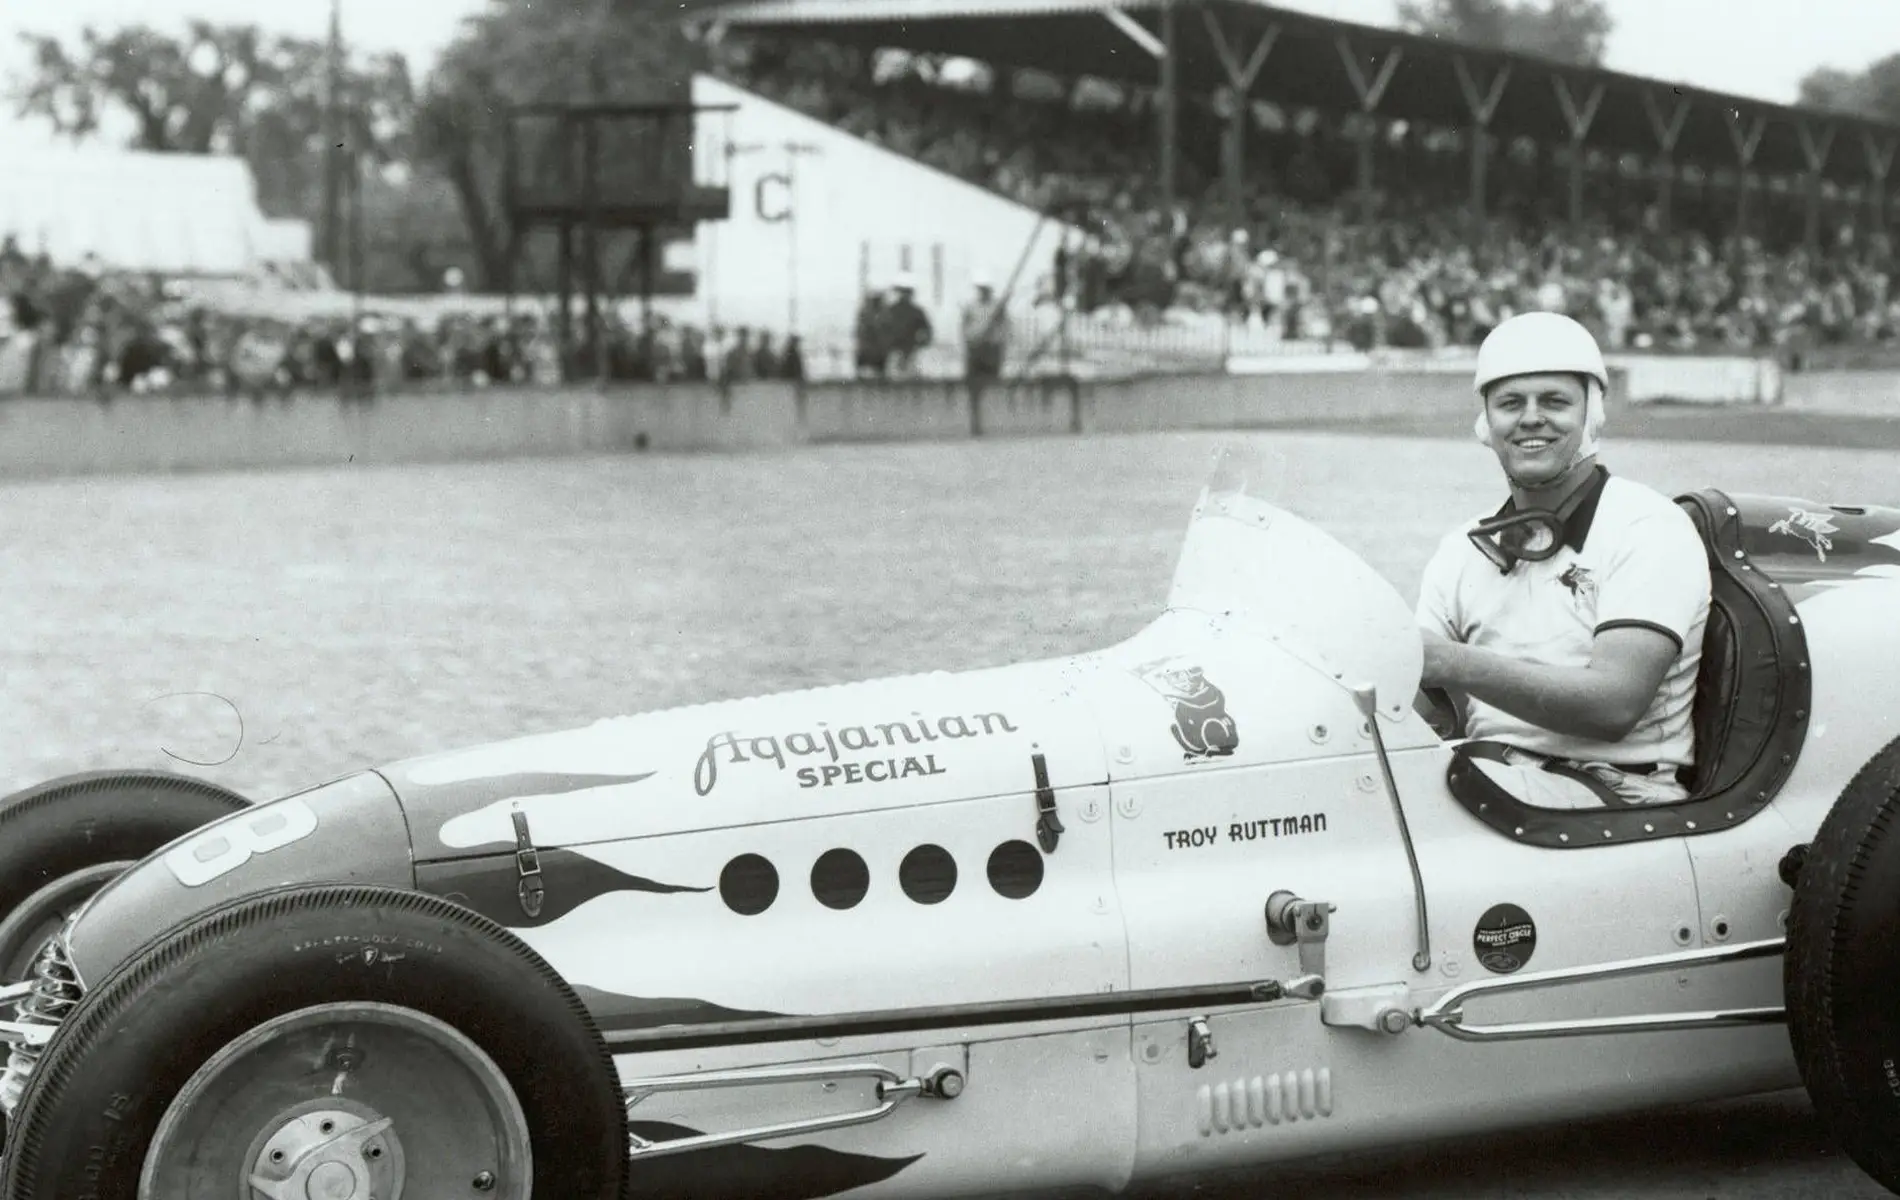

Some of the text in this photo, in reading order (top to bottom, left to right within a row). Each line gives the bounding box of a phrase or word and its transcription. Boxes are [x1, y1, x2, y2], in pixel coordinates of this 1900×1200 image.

[755, 172, 792, 223] C
[796, 754, 946, 788] SPECIAL
[1163, 812, 1327, 850] TROY RUTTMAN
